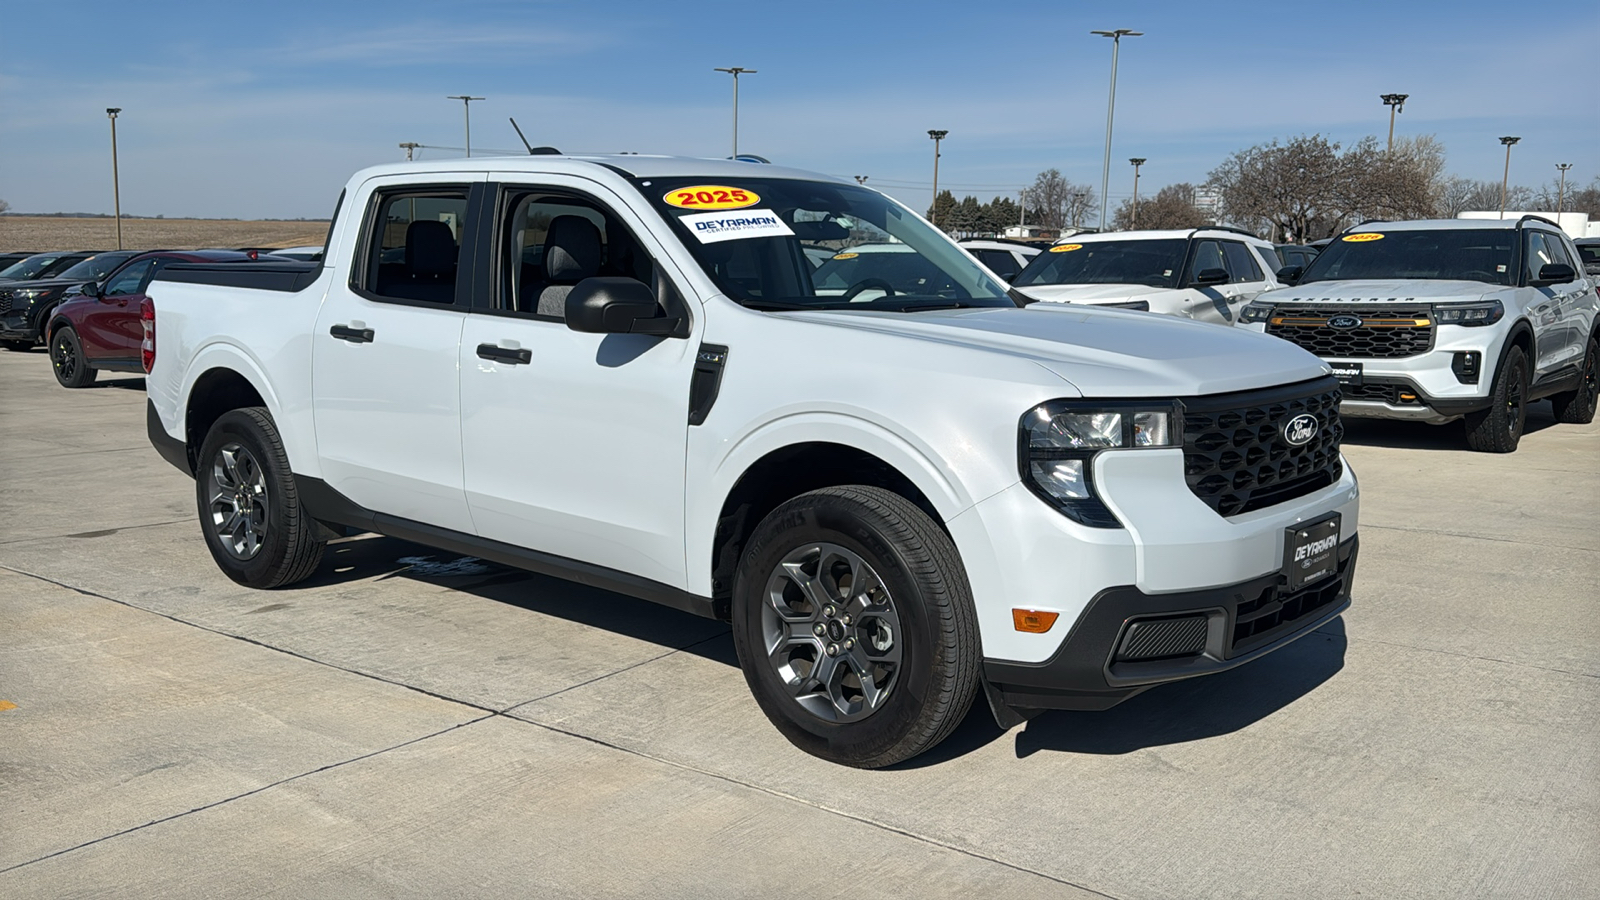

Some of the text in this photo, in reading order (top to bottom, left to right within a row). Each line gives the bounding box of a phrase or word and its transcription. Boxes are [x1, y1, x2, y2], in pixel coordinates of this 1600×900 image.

[677, 190, 748, 205] 2025
[695, 217, 777, 231] DEYARMAN
[1333, 318, 1354, 326] Ford
[1291, 418, 1313, 441] Ford
[1294, 533, 1338, 562] DEYARMAN
